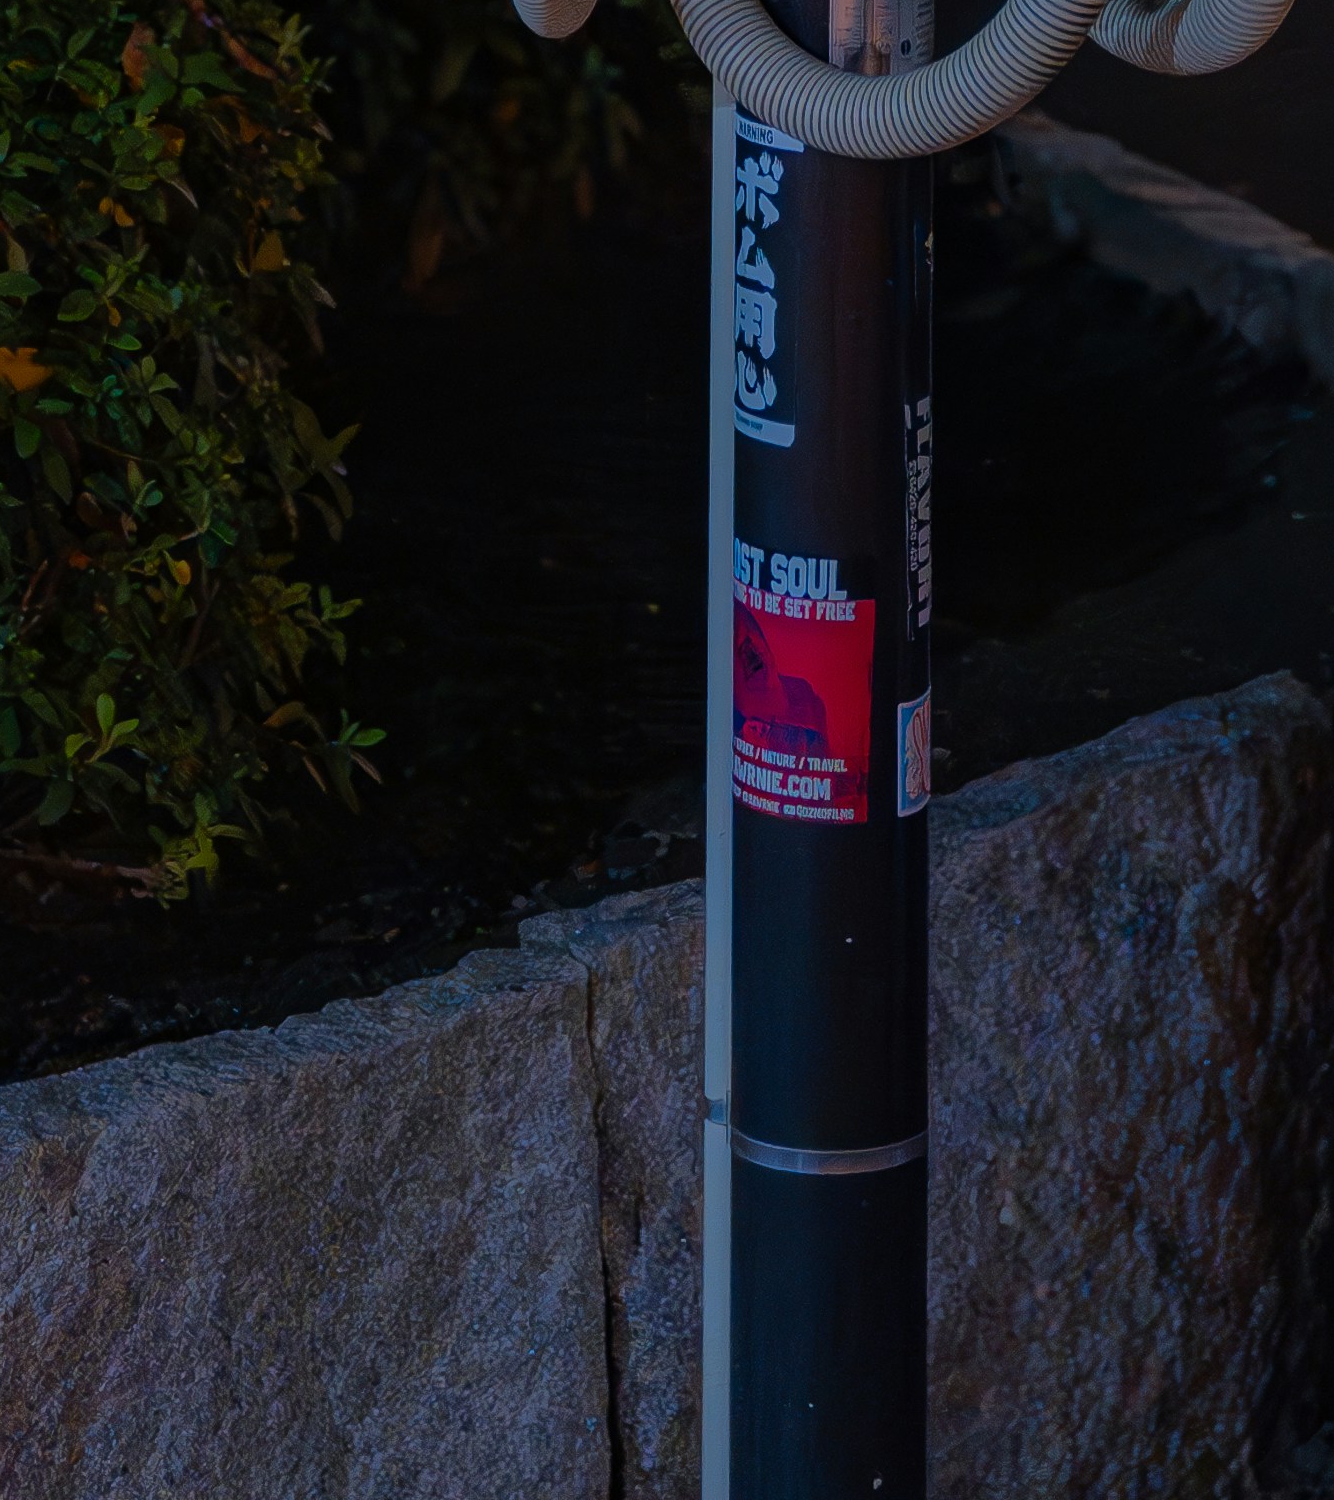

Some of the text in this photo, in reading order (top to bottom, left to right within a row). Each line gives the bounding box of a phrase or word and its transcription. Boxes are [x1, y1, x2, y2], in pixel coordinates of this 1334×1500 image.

[769, 554, 848, 602] SOUL
[764, 596, 783, 617] BE
[785, 597, 815, 620] SET
[816, 599, 856, 623] FREE
